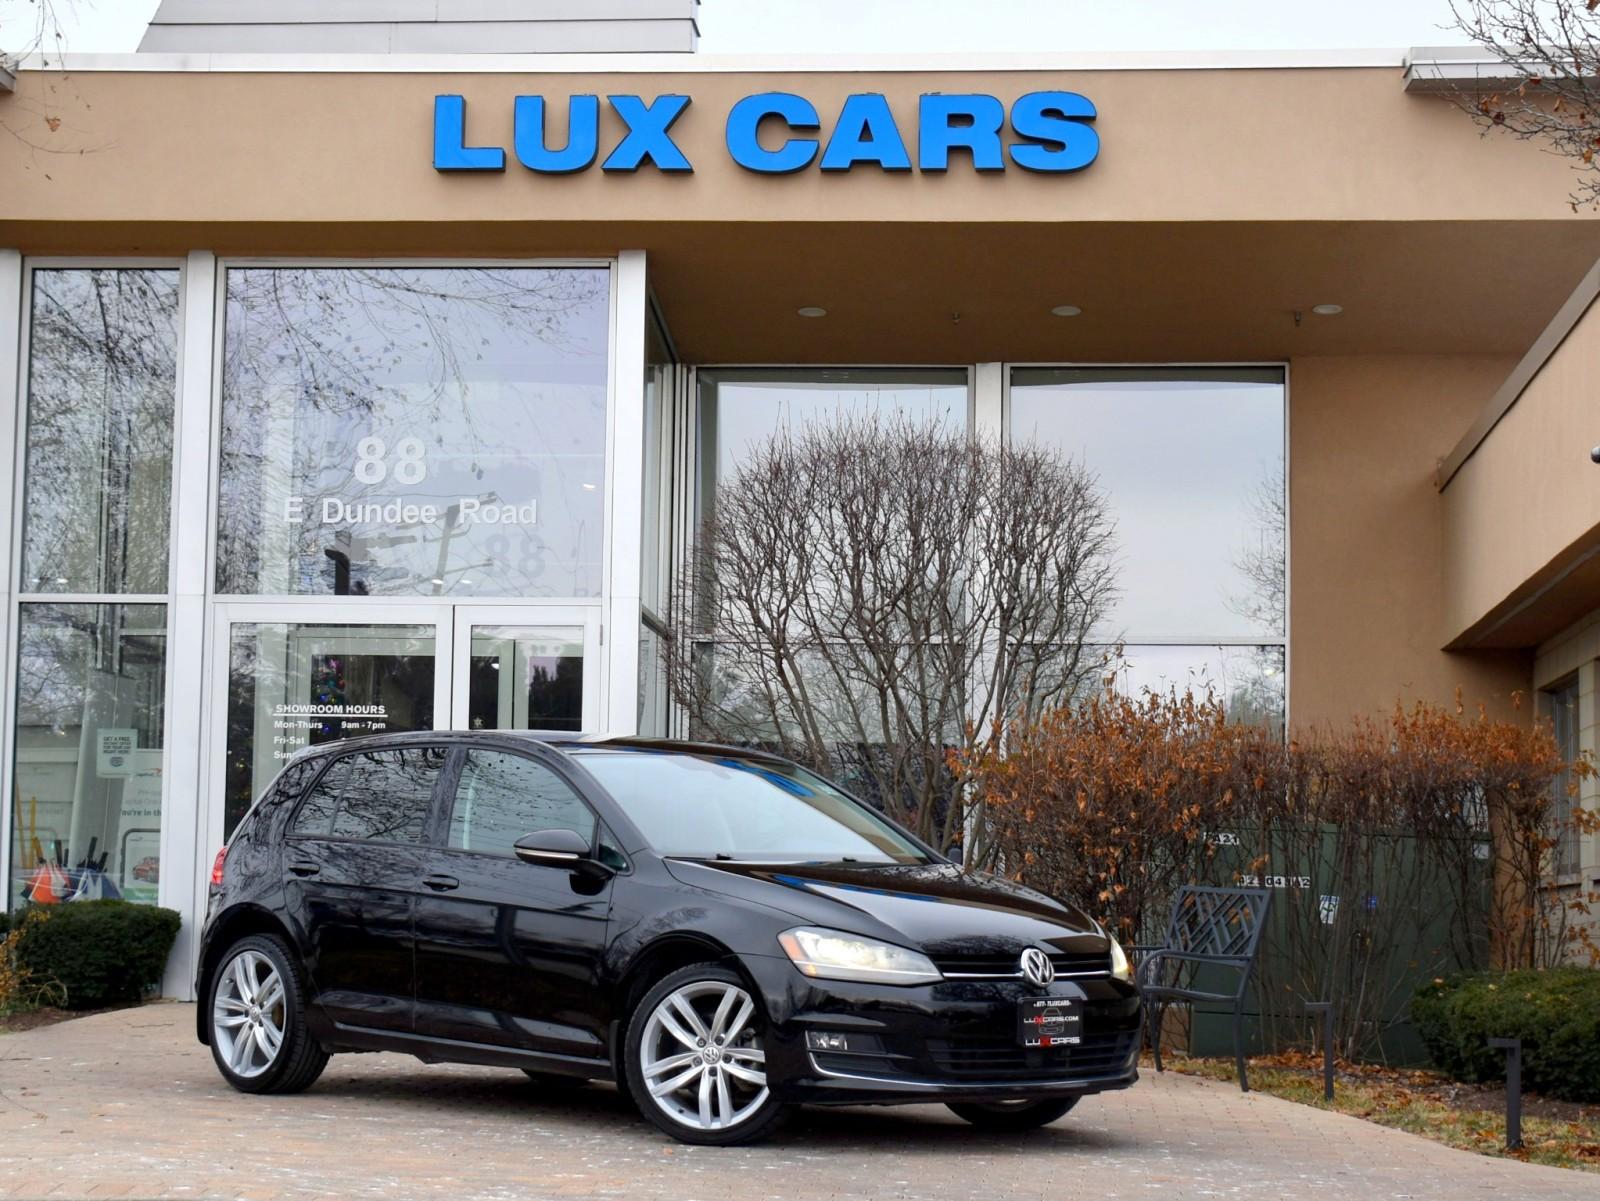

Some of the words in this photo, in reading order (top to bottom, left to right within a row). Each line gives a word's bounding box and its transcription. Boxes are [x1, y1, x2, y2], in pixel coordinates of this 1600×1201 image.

[432, 94, 694, 173] LUX
[725, 91, 1101, 173] CARS
[354, 437, 427, 485] 88
[282, 497, 304, 524] E
[321, 497, 437, 524] Dundee
[459, 498, 538, 525] Road
[276, 704, 343, 714] SHOWROOM
[345, 705, 386, 714] HOURS
[274, 720, 323, 729] Mon-Thurs
[341, 721, 360, 729] 9am
[367, 721, 386, 731] 7pm
[273, 736, 305, 744] Fri-Sat
